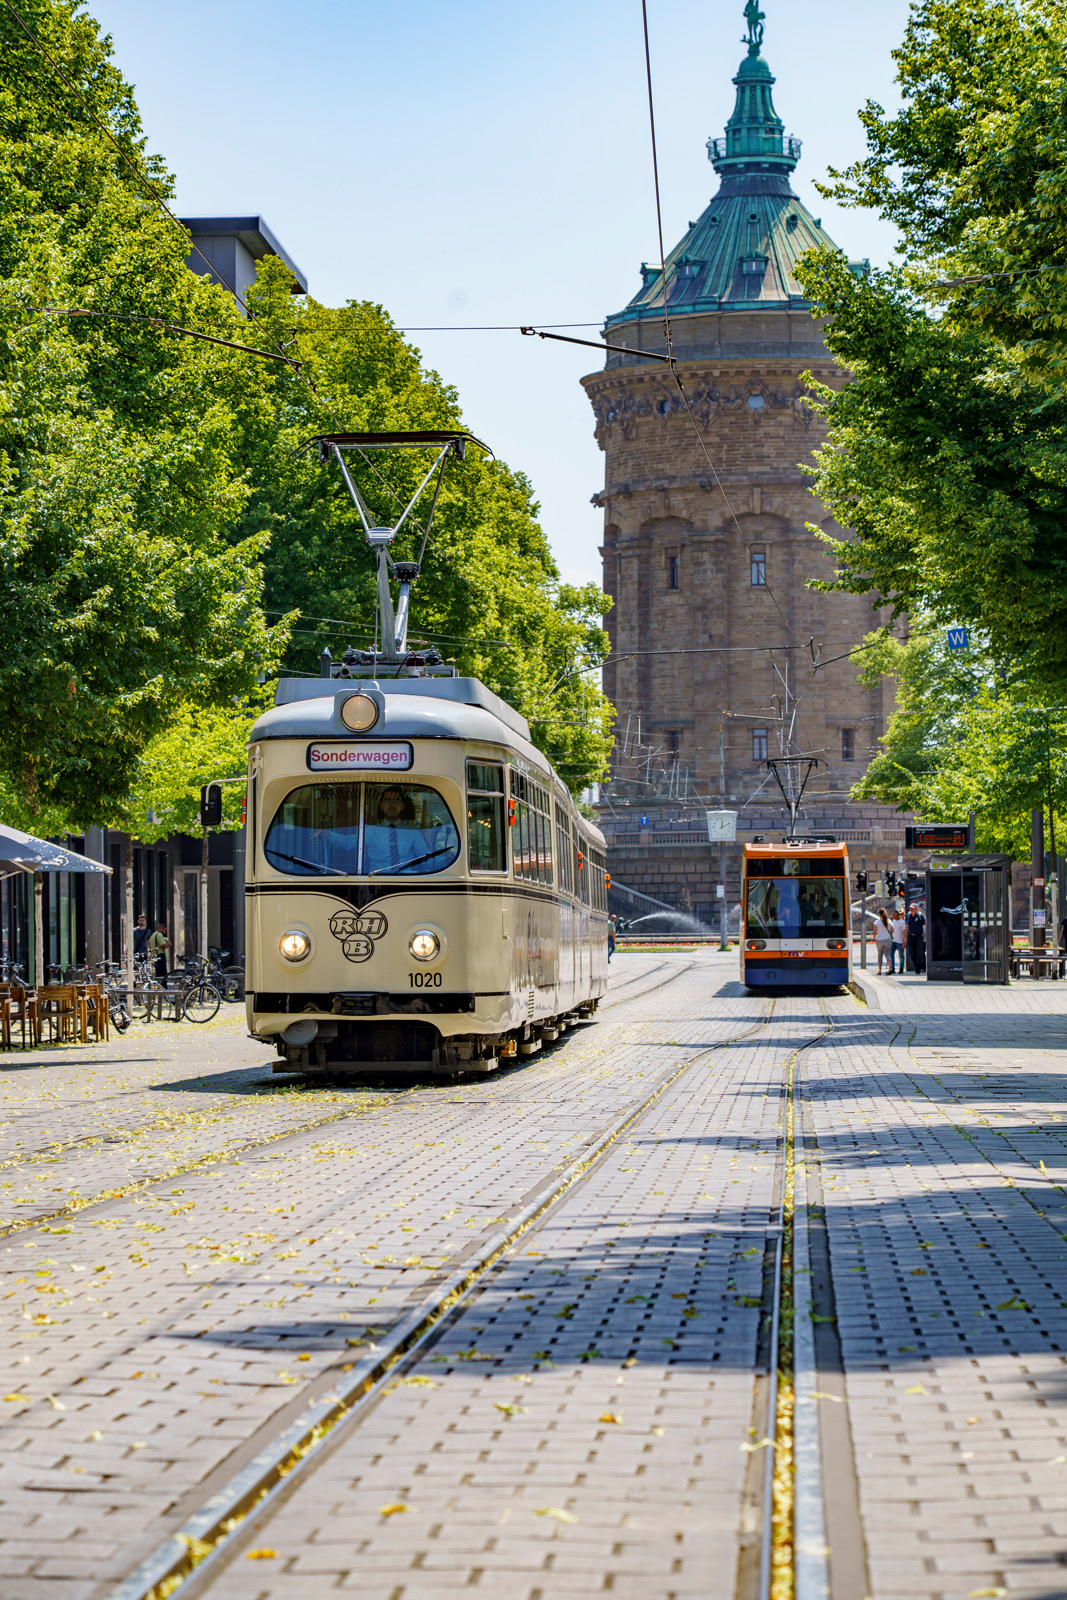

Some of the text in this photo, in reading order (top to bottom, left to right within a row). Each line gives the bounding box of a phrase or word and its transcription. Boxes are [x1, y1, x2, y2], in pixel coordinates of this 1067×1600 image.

[950, 631, 964, 645] W
[311, 750, 408, 764] Sonderwagen
[791, 859, 799, 874] 2
[408, 972, 442, 988] 1020
